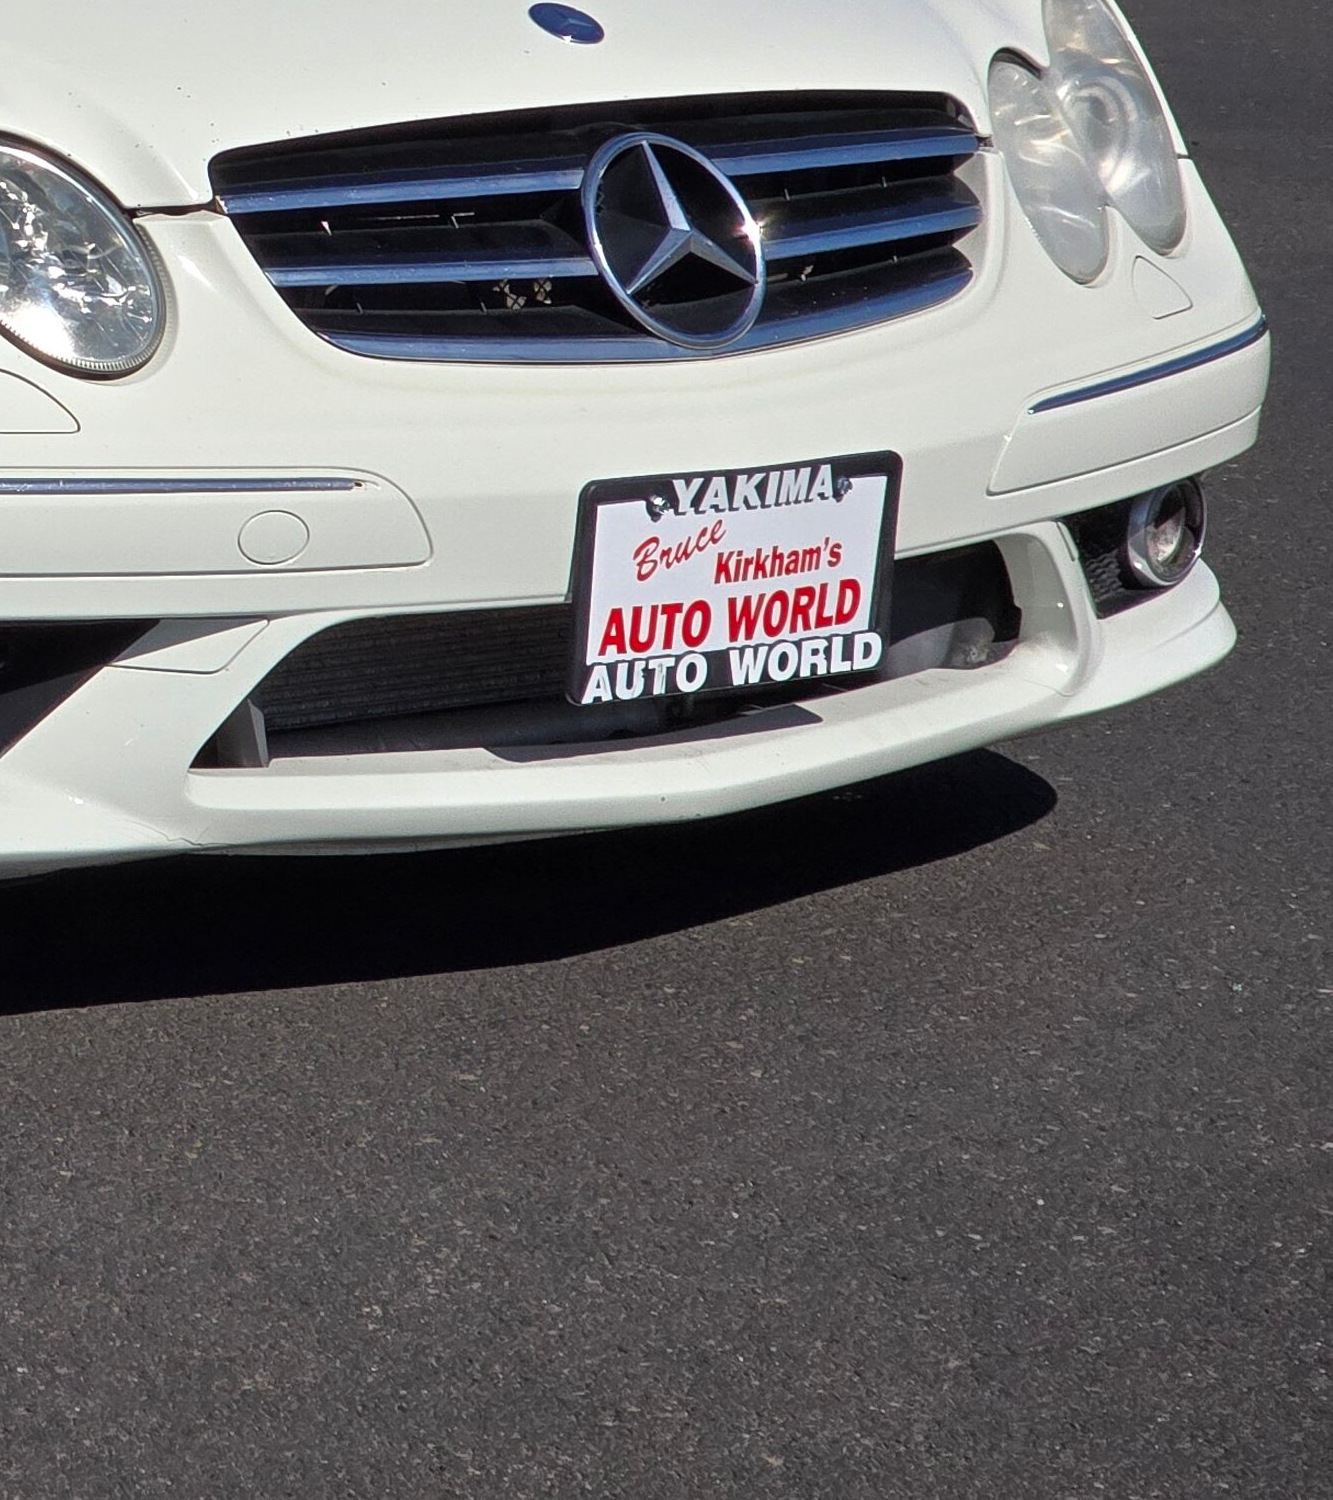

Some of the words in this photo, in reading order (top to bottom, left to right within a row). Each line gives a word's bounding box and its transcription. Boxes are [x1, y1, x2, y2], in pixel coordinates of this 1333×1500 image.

[672, 463, 833, 514] YAKIMA
[633, 519, 726, 582] Bruce
[714, 537, 843, 584] Kirkham's
[598, 600, 712, 656] AUTO
[728, 578, 861, 643] WORLD
[582, 653, 708, 704] AUTO
[730, 632, 882, 686] WORLD
